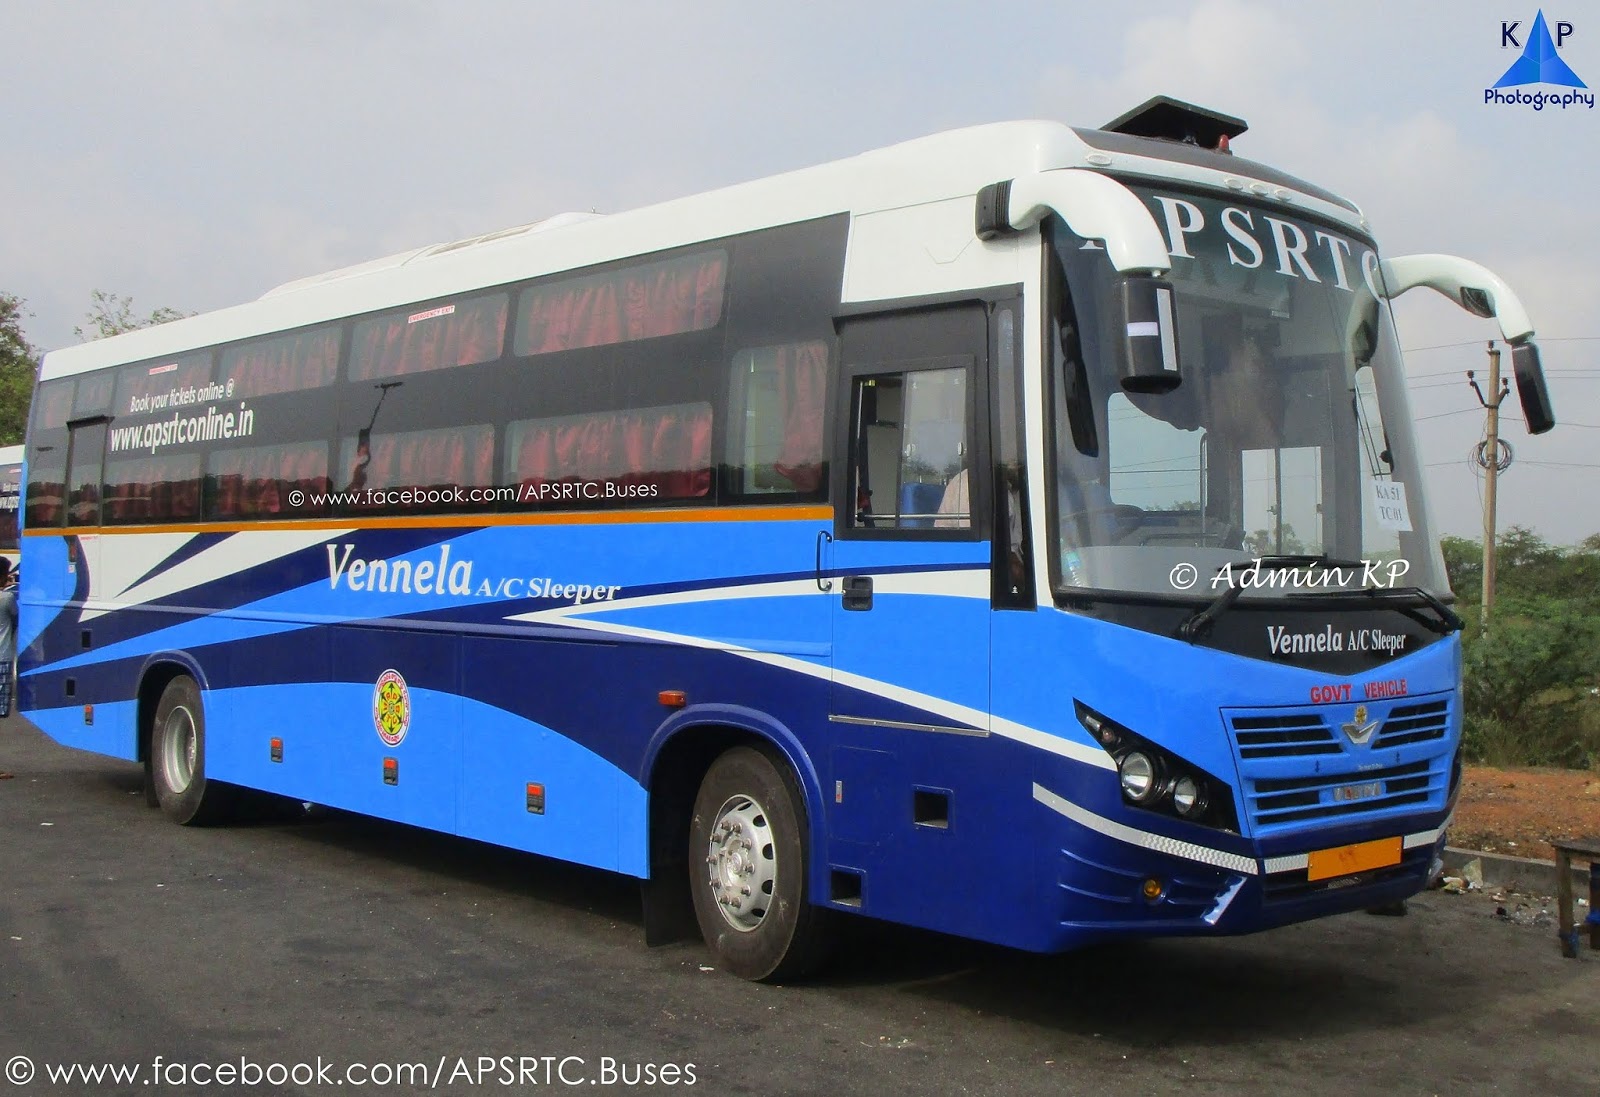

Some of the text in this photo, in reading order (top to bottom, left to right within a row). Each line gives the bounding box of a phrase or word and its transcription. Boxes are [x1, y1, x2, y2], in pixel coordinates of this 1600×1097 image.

[130, 394, 150, 413] Book
[149, 393, 169, 413] your
[169, 385, 197, 407] tickets
[197, 381, 225, 402] online
[111, 401, 254, 455] www.apsrtconline.in
[326, 543, 621, 605] Vennela A/C Sleeper
[1267, 624, 1407, 655] Vennela A/C Sleeper
[1310, 679, 1408, 704] GOVT VEHICLE
